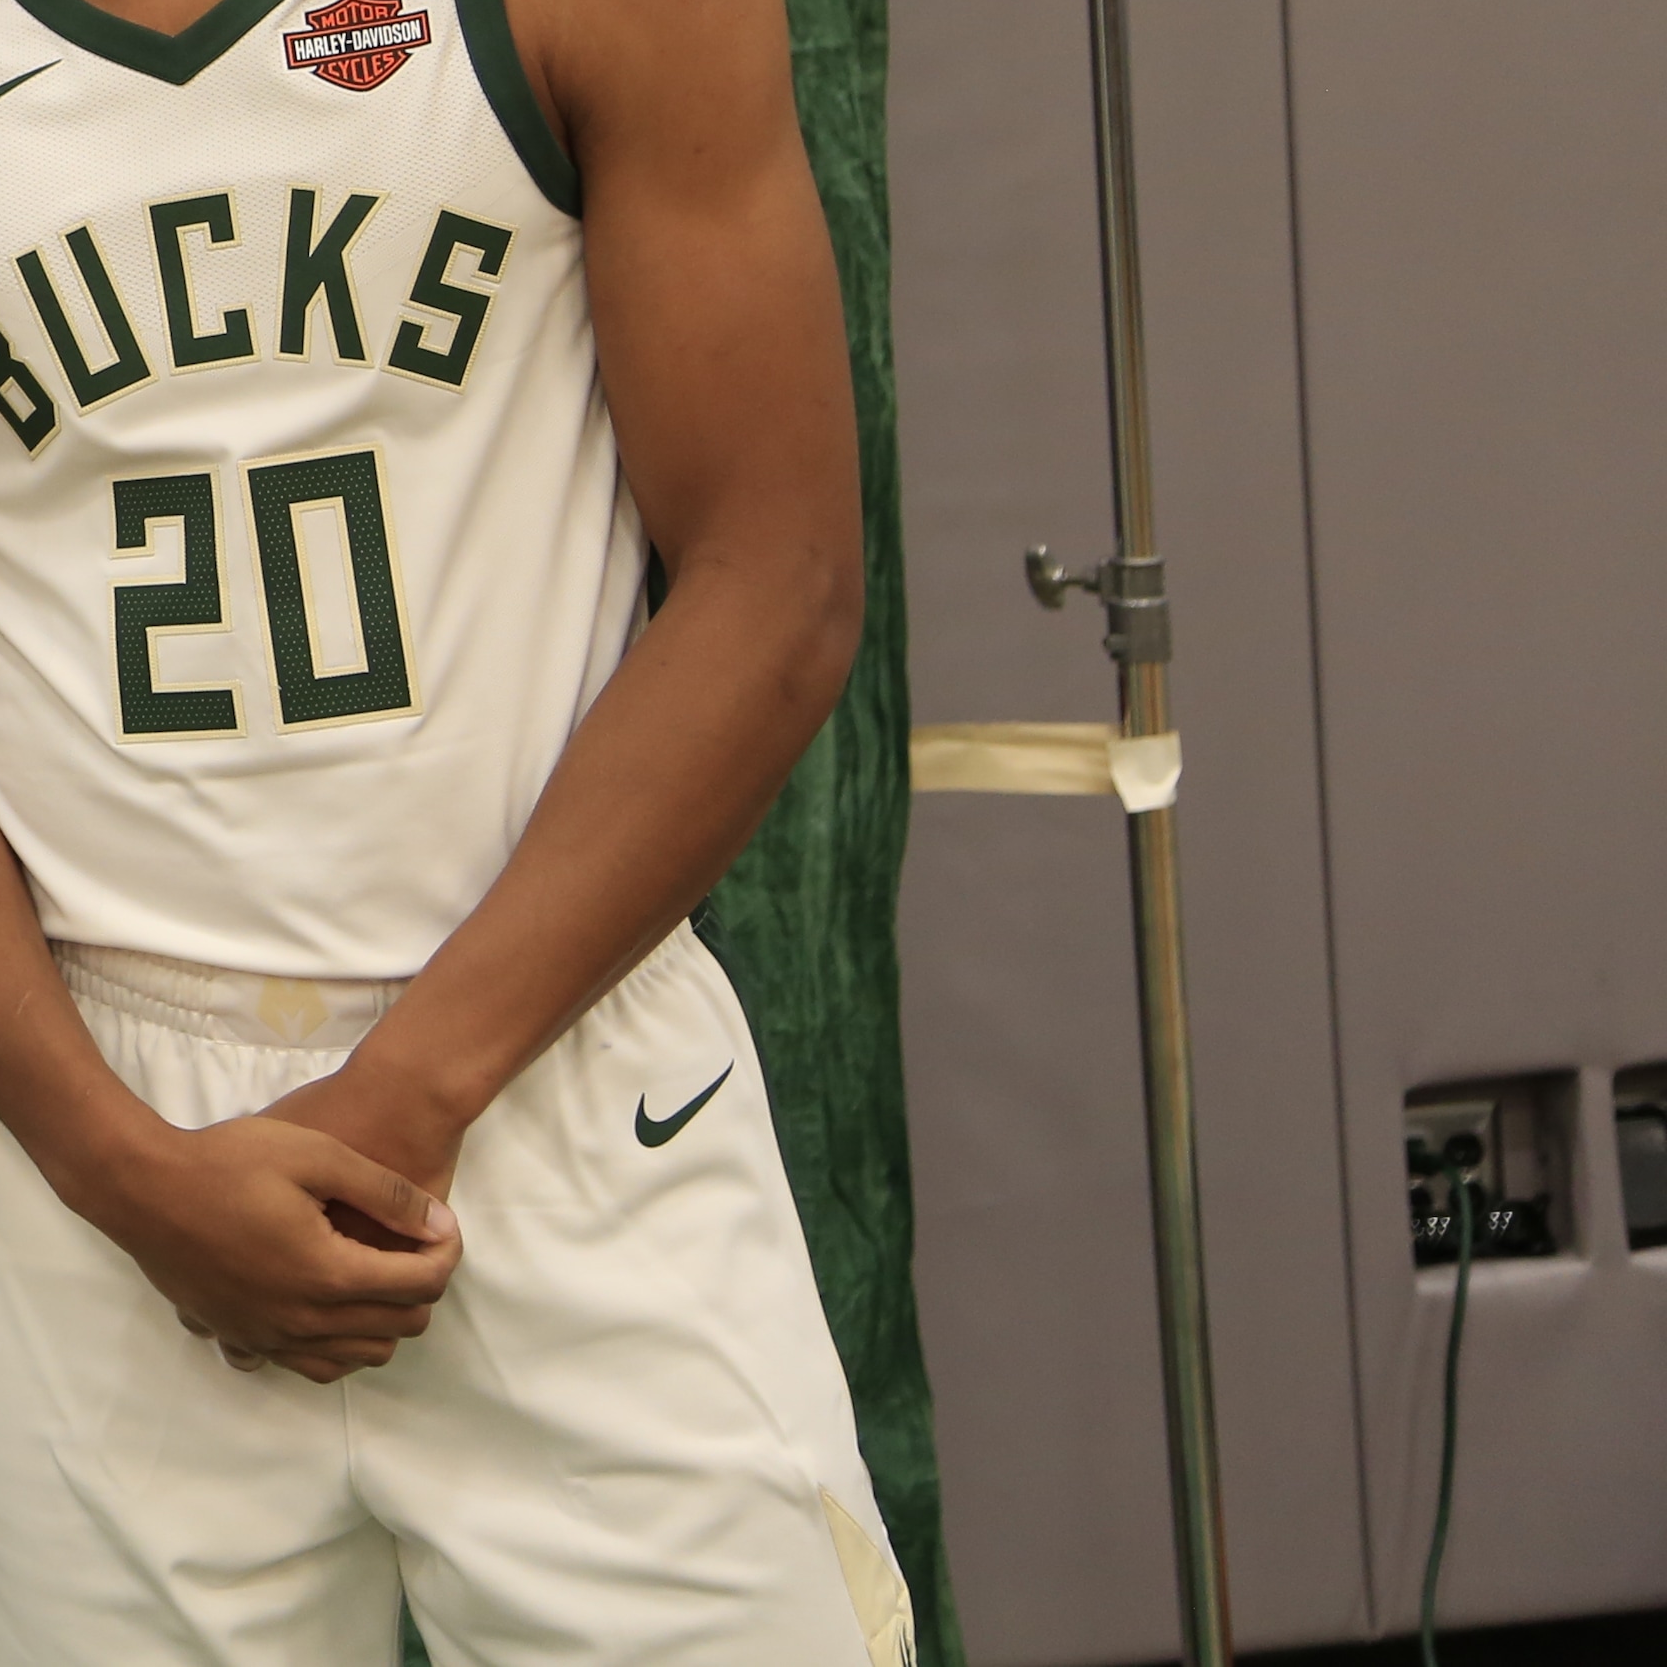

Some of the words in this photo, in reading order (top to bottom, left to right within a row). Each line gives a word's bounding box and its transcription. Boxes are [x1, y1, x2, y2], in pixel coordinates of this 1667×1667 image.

[320, 1, 389, 29] MOTOR
[293, 19, 422, 61] HARLEY-DAVIDSON
[327, 52, 396, 83] CYCLES
[106, 443, 424, 744] 20
